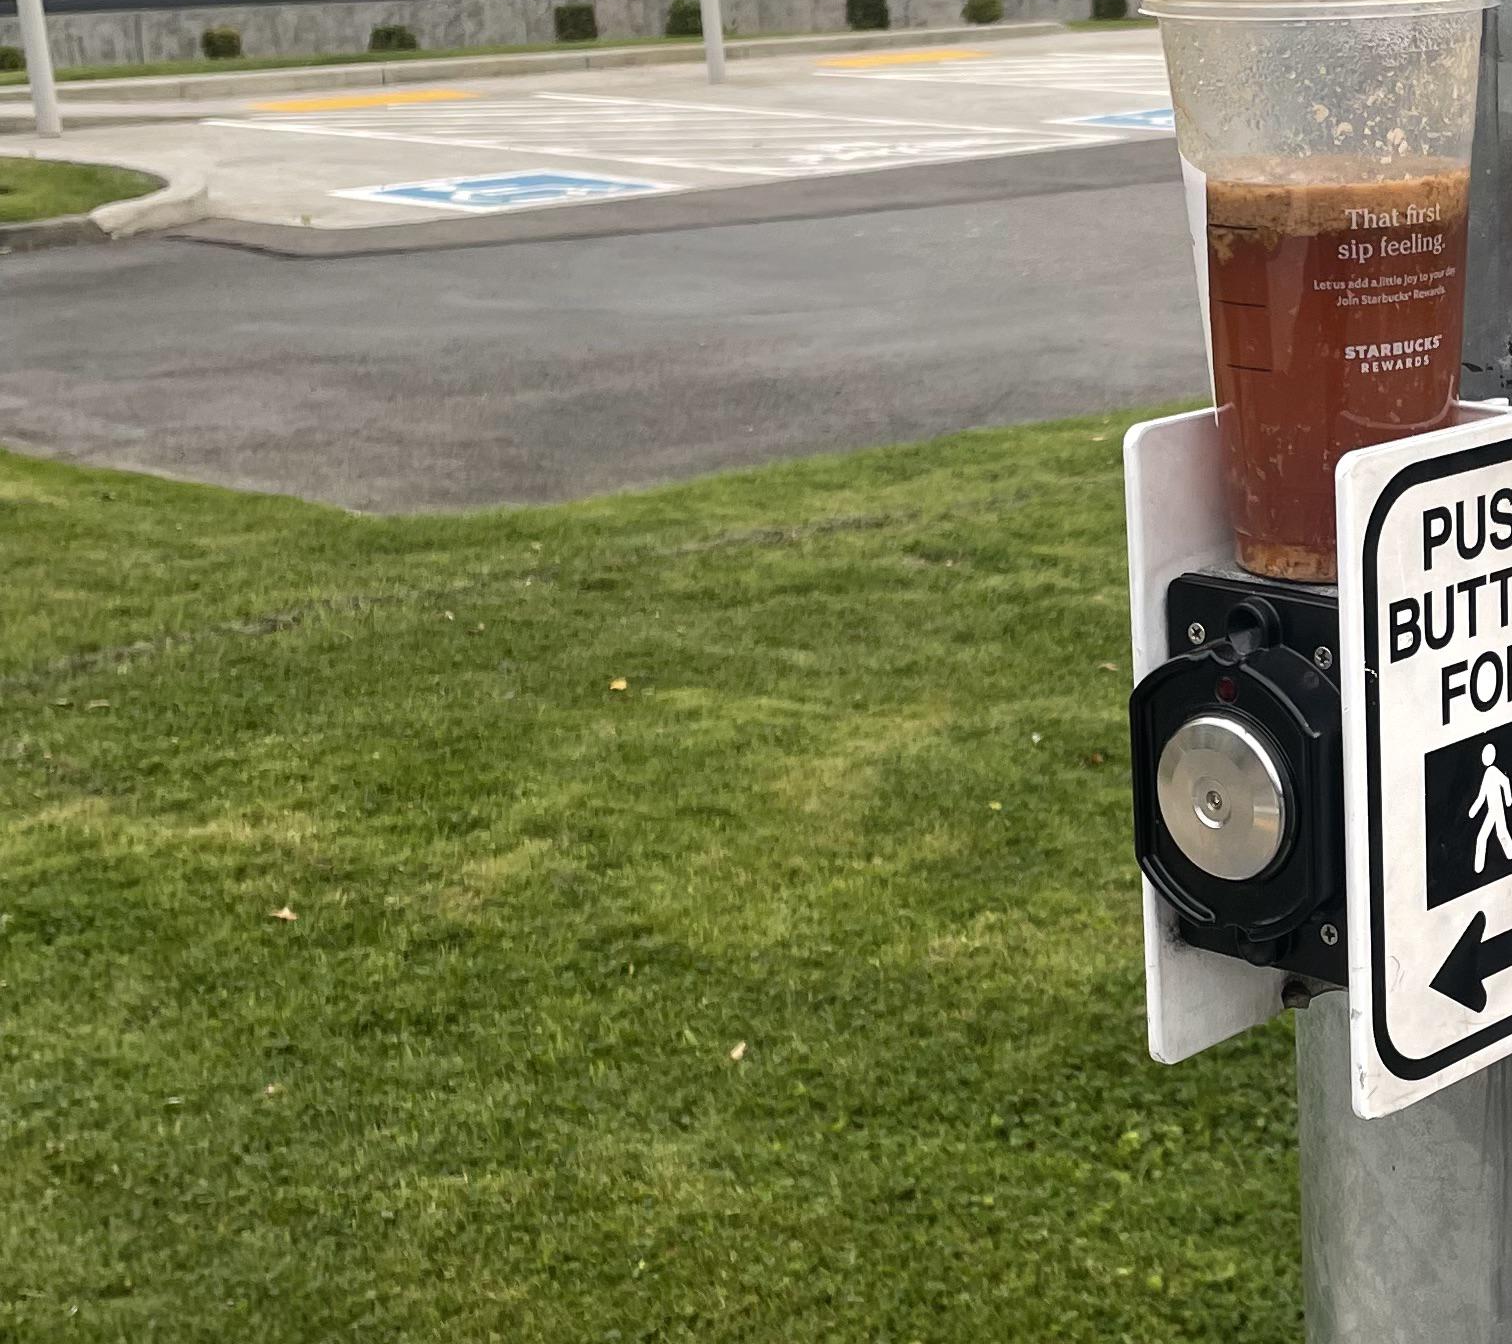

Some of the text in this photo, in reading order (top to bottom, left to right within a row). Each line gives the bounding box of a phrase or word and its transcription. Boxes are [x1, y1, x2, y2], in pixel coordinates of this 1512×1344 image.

[1345, 203, 1441, 230] That first
[1337, 233, 1446, 263] sip feeling.
[1313, 279, 1330, 290] Let
[1331, 281, 1346, 289] us
[1348, 277, 1369, 288] add
[1379, 275, 1402, 287] little
[1403, 274, 1418, 286] joy
[1419, 272, 1429, 282] to
[1336, 295, 1360, 306] Join
[1361, 355, 1430, 373] REWARDS
